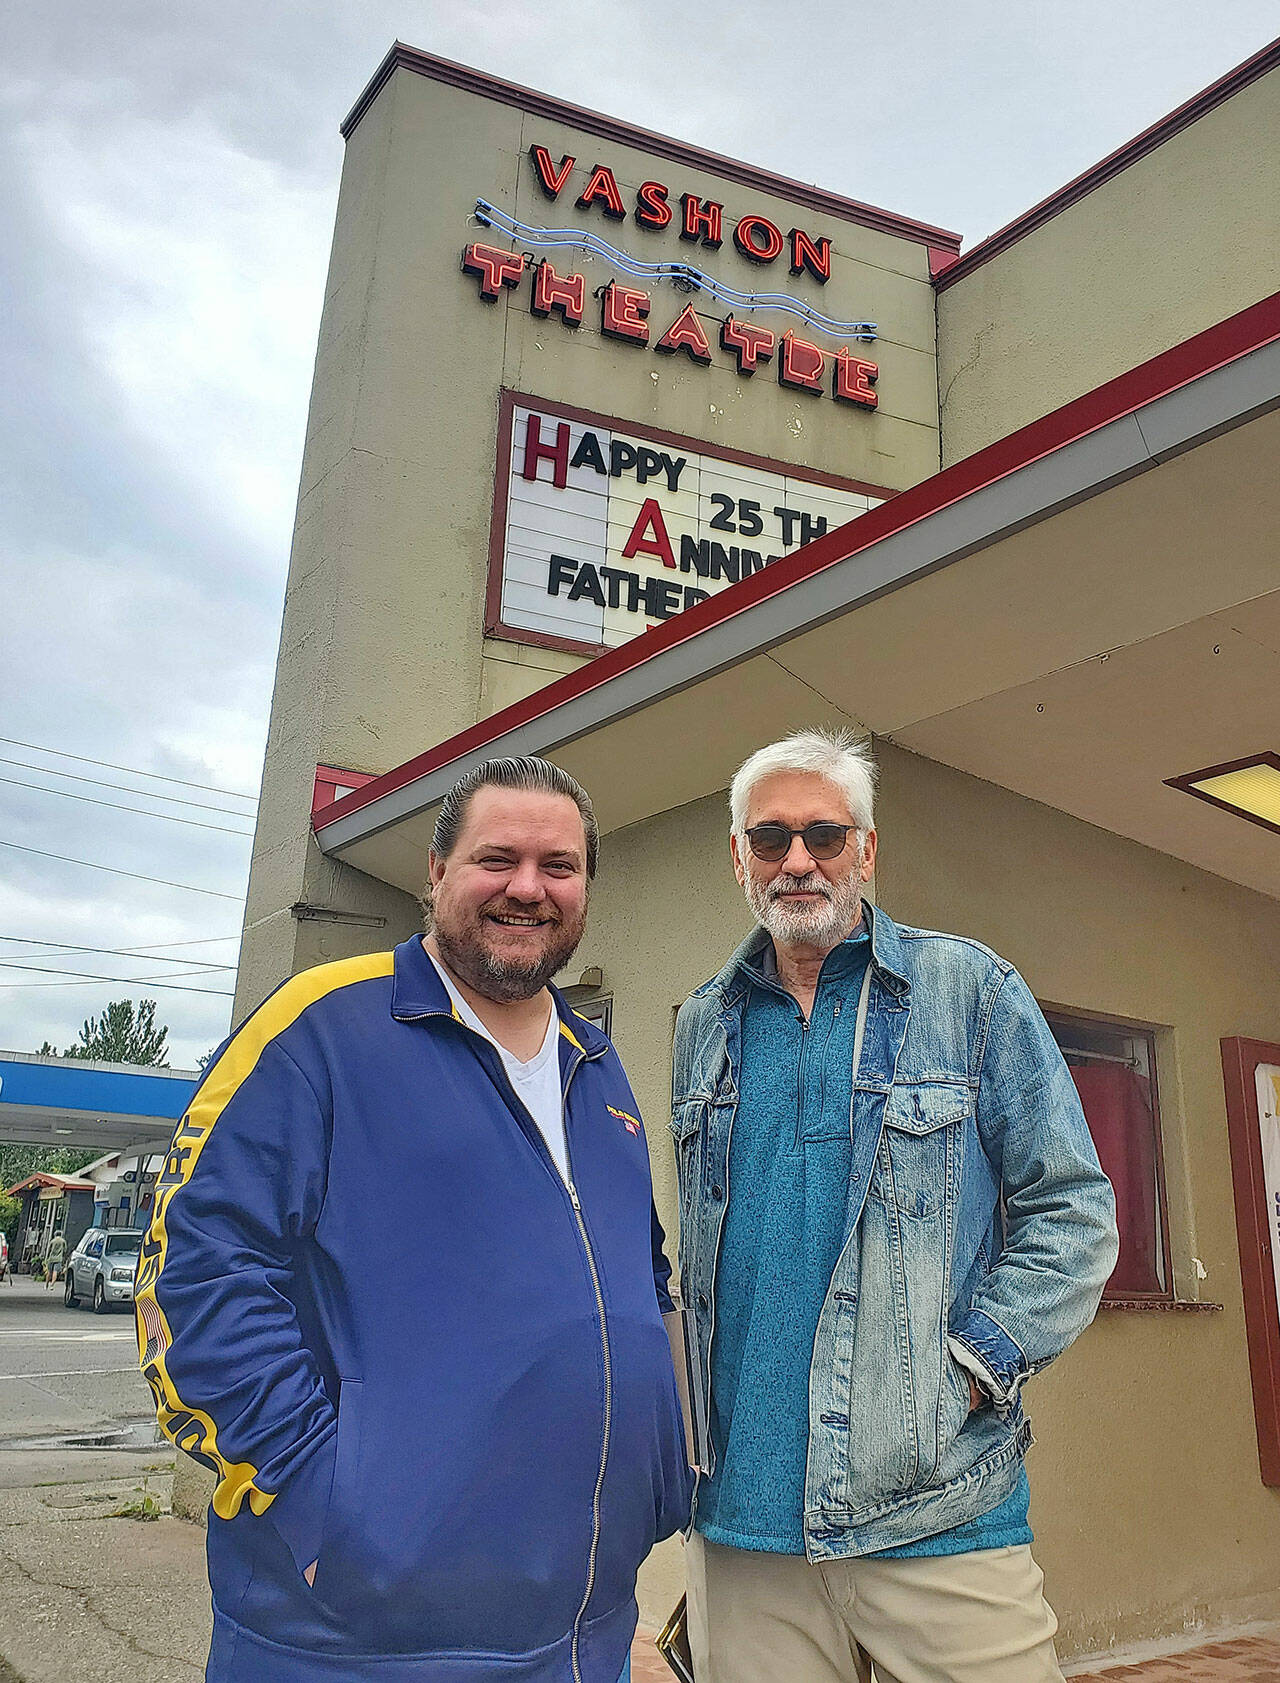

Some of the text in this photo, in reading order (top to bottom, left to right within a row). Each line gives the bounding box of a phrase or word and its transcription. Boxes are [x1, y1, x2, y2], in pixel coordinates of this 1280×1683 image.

[529, 144, 832, 285] VASHON
[460, 242, 879, 411] THEATRE
[522, 413, 686, 492] HAPPY
[709, 493, 764, 537] 25
